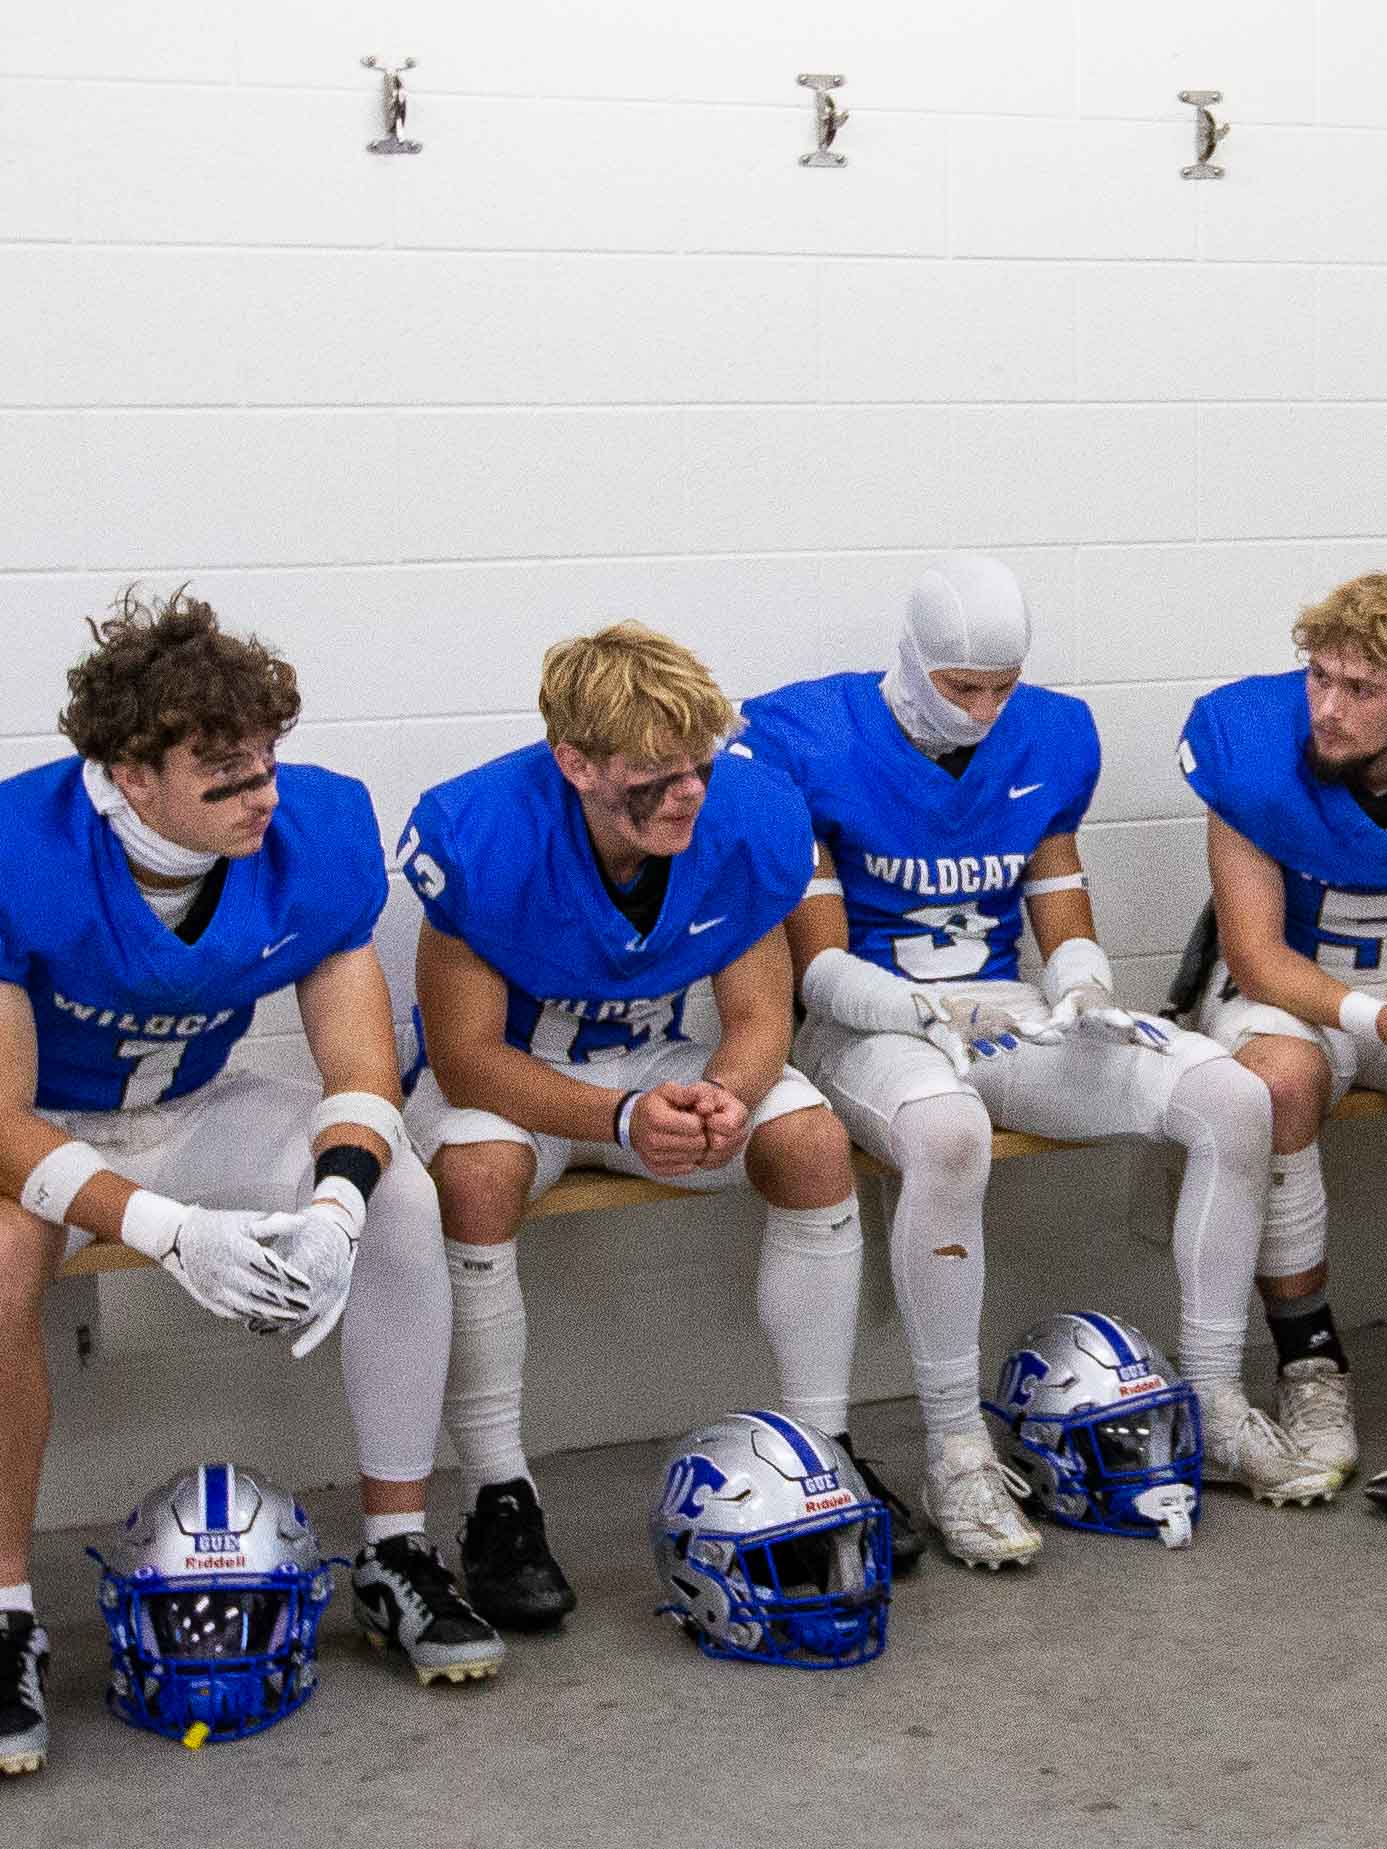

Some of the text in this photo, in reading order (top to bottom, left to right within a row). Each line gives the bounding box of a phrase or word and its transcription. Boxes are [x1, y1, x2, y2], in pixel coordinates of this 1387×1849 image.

[893, 901, 1000, 981] 3
[118, 1040, 188, 1110] 7
[1120, 1377, 1160, 1397] Riddell
[806, 1494, 852, 1513] Riddell
[186, 1555, 246, 1569] Riddell
